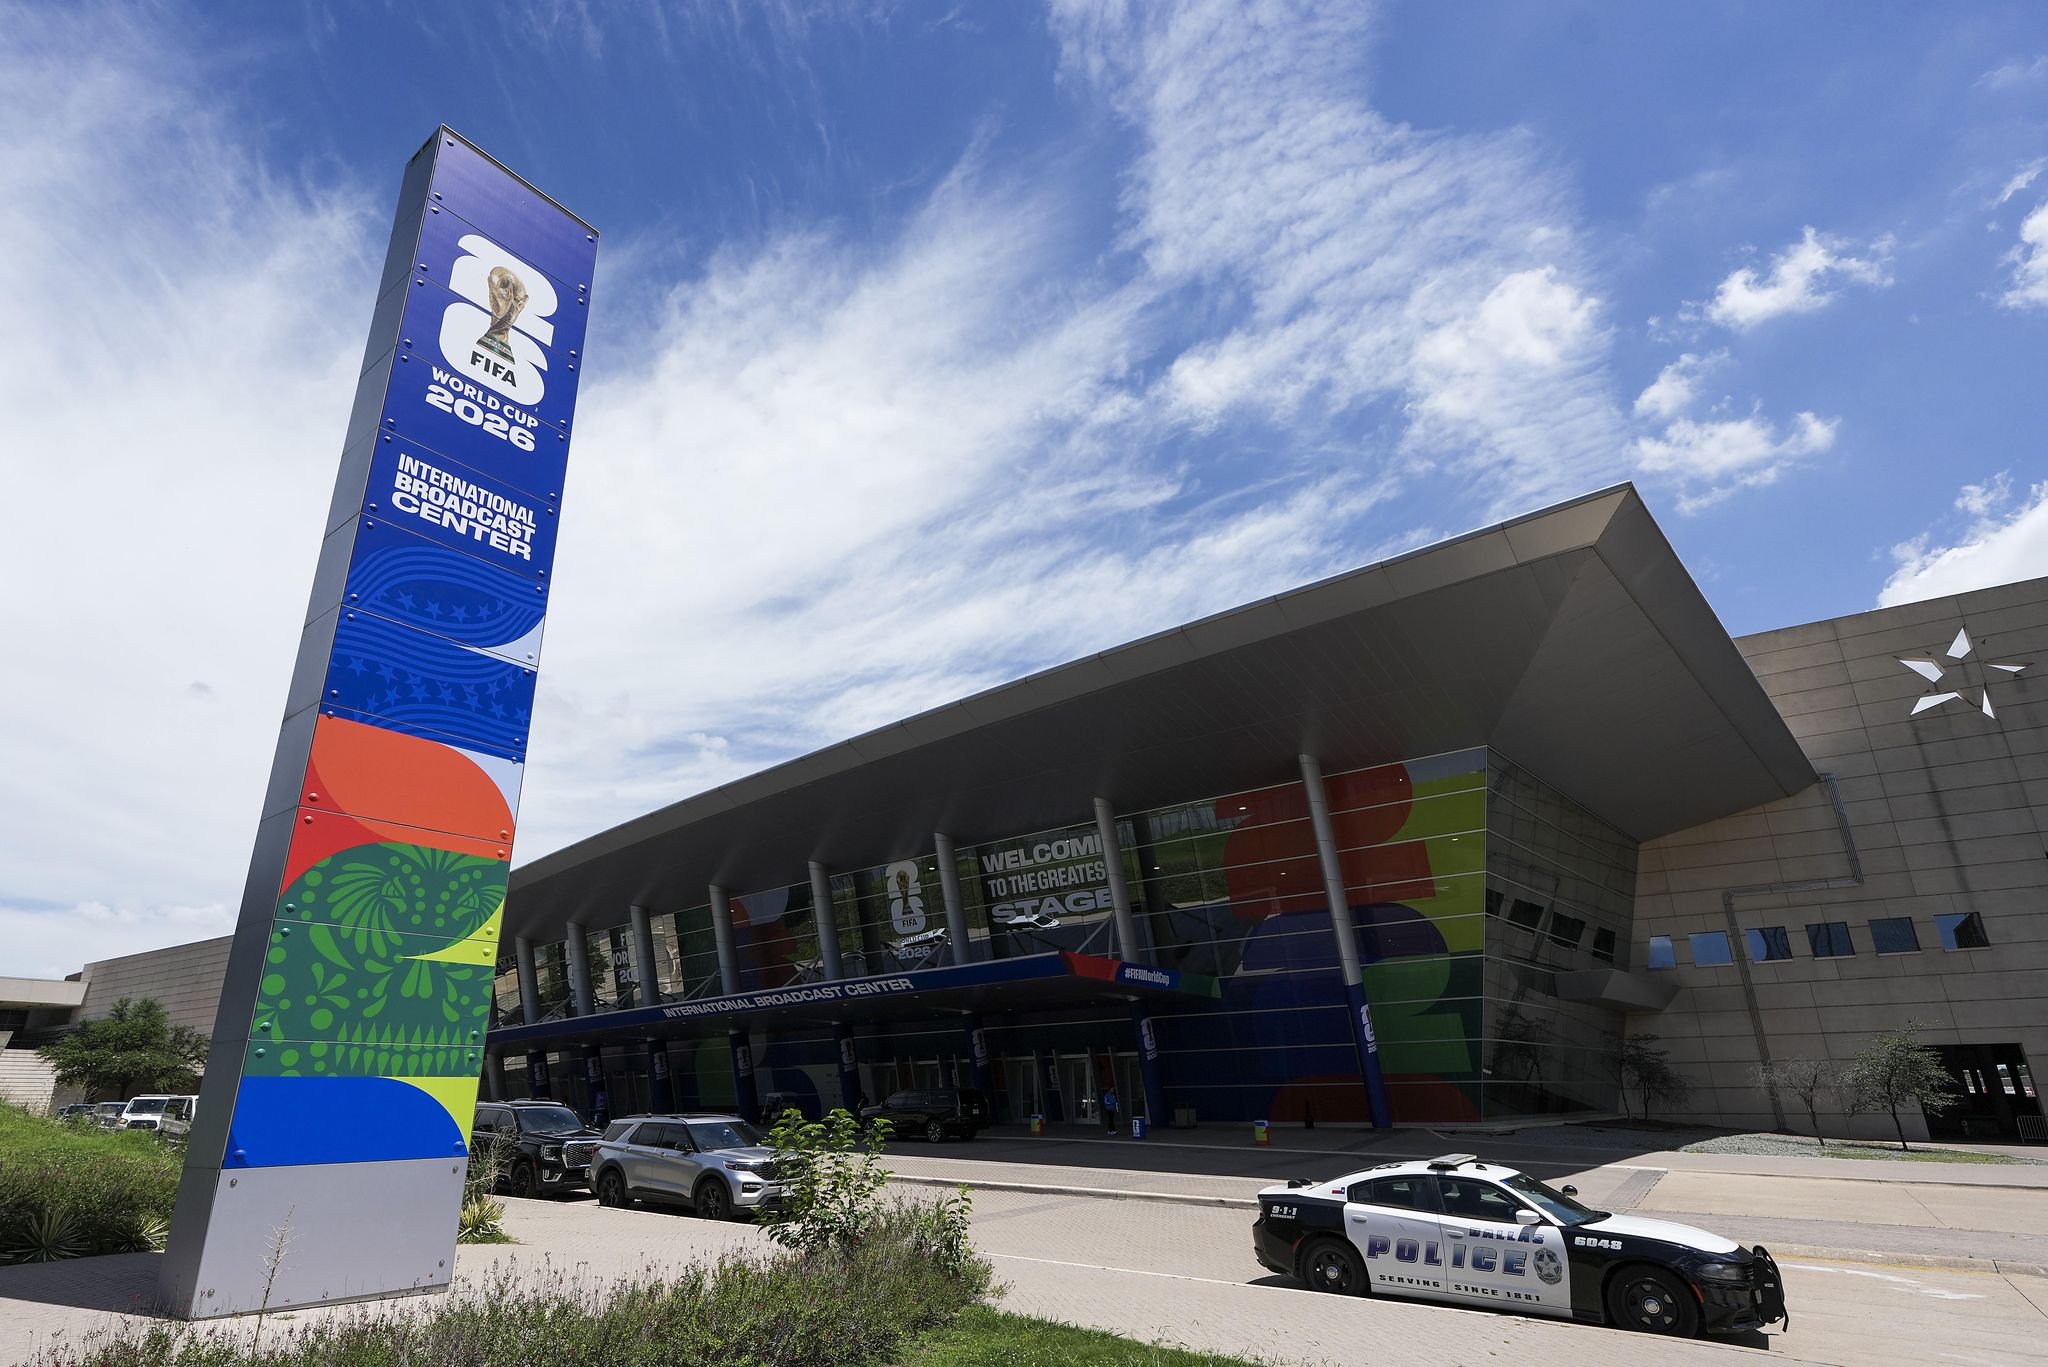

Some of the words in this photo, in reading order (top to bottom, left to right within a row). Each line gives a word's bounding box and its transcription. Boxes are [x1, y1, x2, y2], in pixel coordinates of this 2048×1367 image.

[470, 350, 517, 387] FIFA
[432, 366, 500, 410] WORLD
[503, 404, 539, 428] CUP
[425, 384, 536, 452] 2026
[394, 471, 535, 543] BROADCAST
[398, 452, 536, 528] INTERNATIONAL
[392, 491, 531, 561] CENTER
[988, 878, 1008, 897] TO
[1009, 872, 1038, 895] THE
[1037, 860, 1107, 890] GREATES
[902, 918, 918, 928] FIFA
[991, 887, 1113, 924] STAGE
[898, 945, 931, 960] 2026
[662, 998, 754, 1018] INTERNATIONAL
[756, 986, 842, 1008] BROADCAST
[843, 978, 915, 997] CENTER
[1469, 1227, 1545, 1244] DALLAS
[1574, 1236, 1622, 1250] 6048
[1366, 1234, 1527, 1276] POLICE
[1379, 1274, 1440, 1288] SERVING
[1454, 1284, 1499, 1296] SINCE
[1506, 1291, 1541, 1302] 1881
